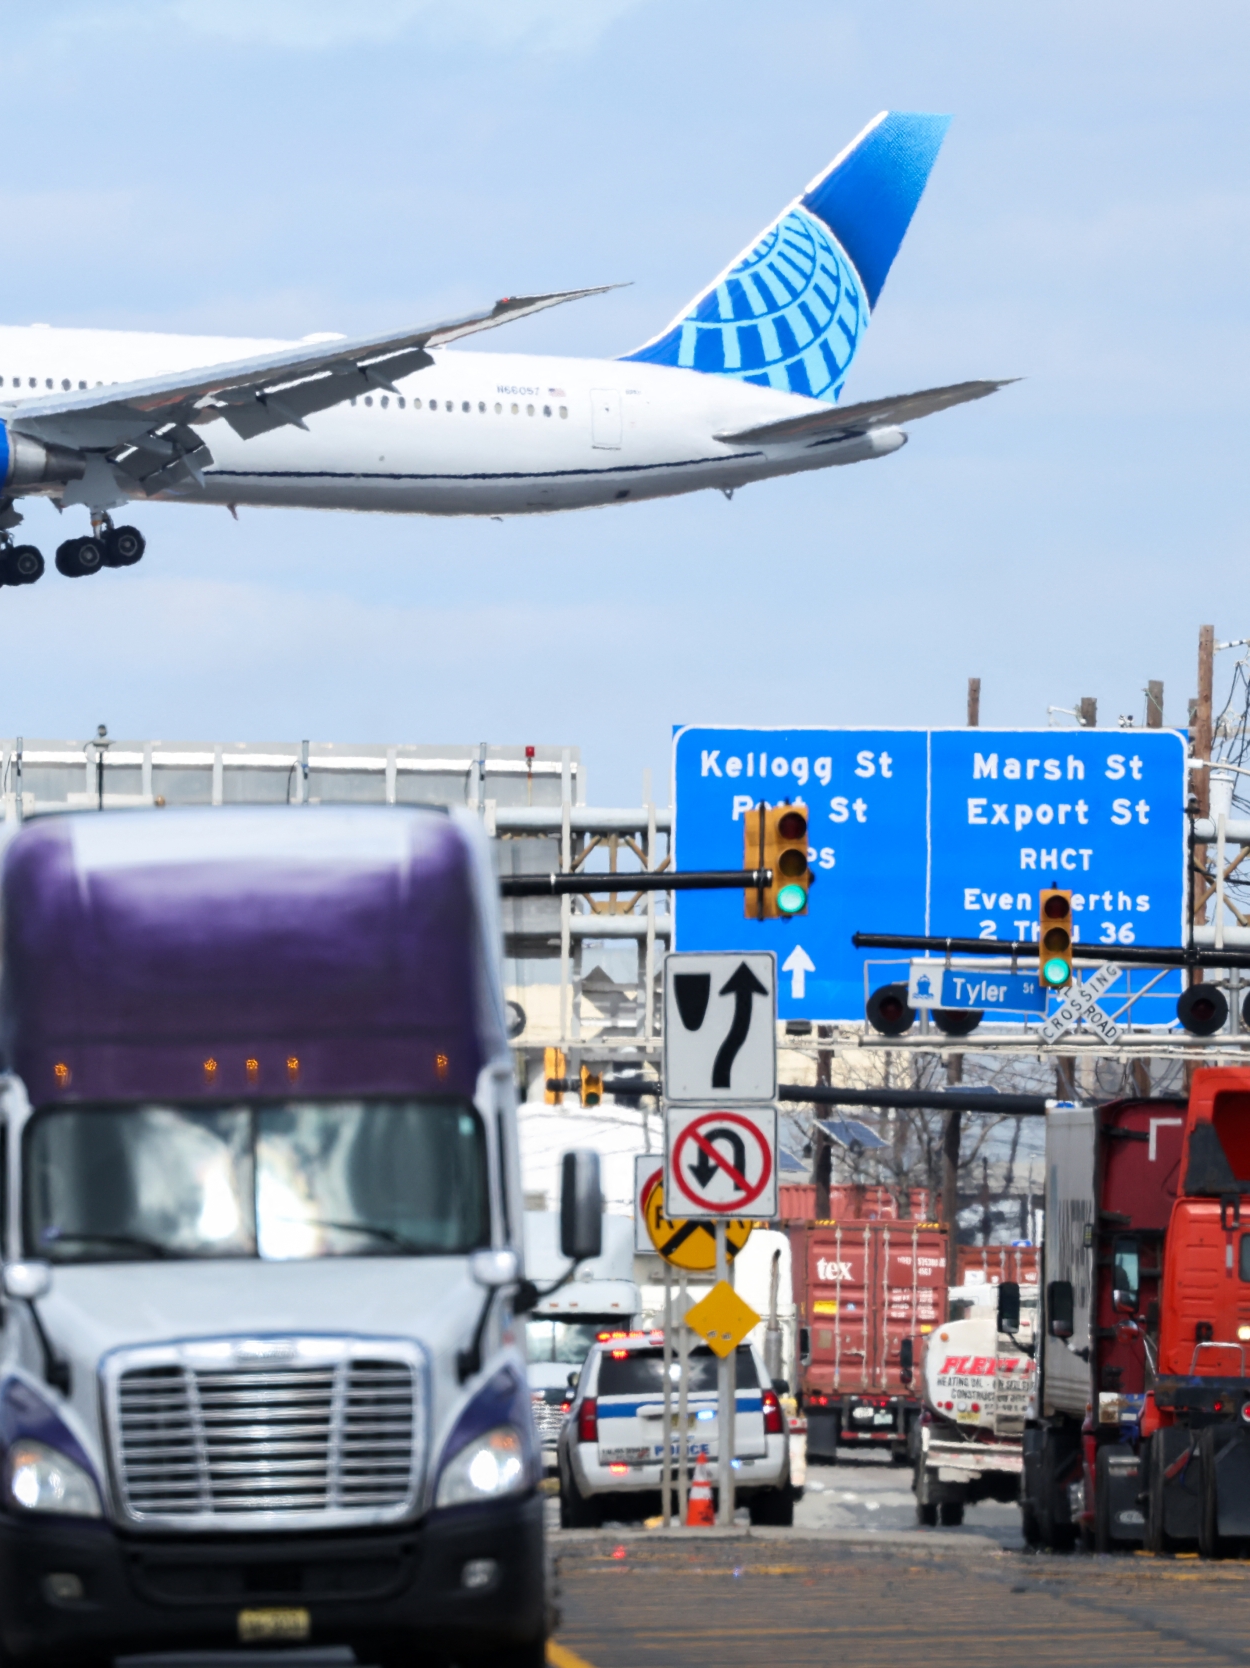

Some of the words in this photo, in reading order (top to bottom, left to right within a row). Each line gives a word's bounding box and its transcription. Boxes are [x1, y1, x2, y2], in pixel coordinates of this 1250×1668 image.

[700, 750, 833, 786] Kellogg
[854, 750, 893, 778] St
[972, 752, 1085, 781] Marsh
[1104, 754, 1143, 780] St
[829, 796, 868, 823] St
[967, 798, 1089, 832] Export
[1110, 798, 1150, 826] St
[1020, 848, 1093, 871] RHCT
[963, 888, 1032, 911] Even
[1071, 890, 1150, 912] erths
[978, 919, 998, 941] 2
[1013, 920, 1081, 943] Thu
[1099, 922, 1136, 944] 36
[953, 977, 1008, 1005] Tyler
[1022, 982, 1035, 995] St
[1042, 964, 1118, 1039] CROSSING
[1083, 1005, 1117, 1039] ROAD
[654, 1443, 710, 1456] PLCE
